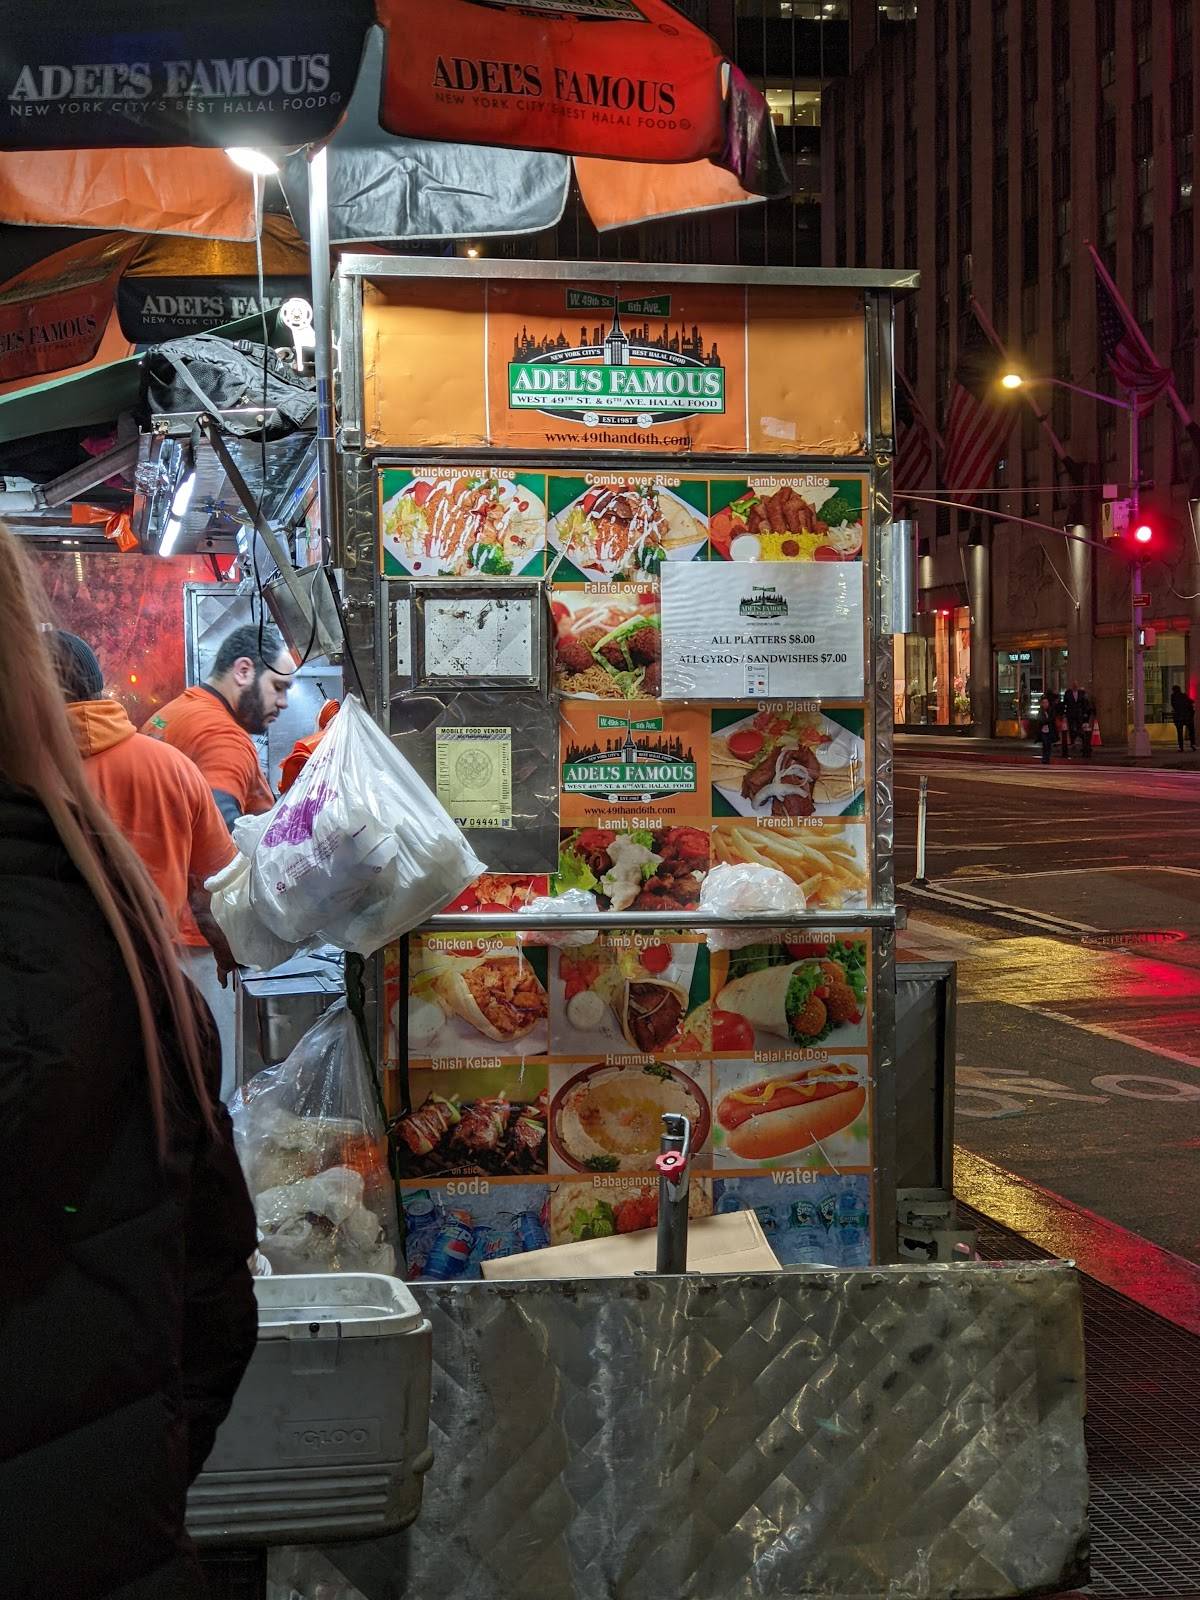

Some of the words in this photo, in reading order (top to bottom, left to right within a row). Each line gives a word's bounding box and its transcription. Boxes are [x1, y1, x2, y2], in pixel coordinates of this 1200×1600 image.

[8, 62, 152, 101] ADEL'S
[162, 54, 331, 98] FAMOUS
[433, 55, 543, 97] ADEL'S
[554, 66, 676, 115] FAMOUS
[10, 104, 49, 117] NEW
[59, 102, 102, 114] YORK
[112, 101, 166, 113] CITY'S
[176, 100, 214, 113] BEST
[224, 101, 275, 113] HALAL
[435, 92, 465, 105] NEW
[472, 94, 510, 110] YORK
[559, 106, 586, 121] BEST
[592, 112, 631, 127] HALAL
[141, 295, 224, 318] ADEL'S
[230, 297, 282, 318] FAM
[582, 295, 599, 306] 49th
[627, 303, 641, 312] 6th
[643, 301, 661, 313] Ave.
[142, 316, 165, 324] NEW
[30, 314, 97, 345] FAMOUS
[550, 353, 564, 362] NEW
[564, 350, 581, 359] YORK
[582, 349, 601, 357] CITY'S
[648, 351, 668, 360] HALAL
[668, 355, 686, 365] FOOD
[514, 368, 603, 392] ADEL'S
[609, 370, 720, 395] FAMOUS
[517, 396, 547, 404] WEST
[551, 396, 574, 404] 49TH
[577, 397, 593, 405] ST.
[624, 398, 648, 406] AVE.
[649, 399, 684, 407] HALAL
[688, 400, 717, 408] FOOD
[545, 432, 692, 447] www.49thand6th.com
[412, 467, 460, 478] Chicken
[461, 469, 487, 479] over
[490, 468, 515, 480] Rice
[585, 474, 624, 487] Combo
[628, 477, 651, 487] over
[656, 475, 680, 487] Rice
[747, 476, 776, 487] Lamb
[777, 478, 803, 488] over
[806, 476, 830, 487] Rice
[584, 582, 621, 594] Falafel
[623, 584, 649, 594] over
[711, 635, 732, 645] ALL
[735, 635, 787, 645] PLATTERS
[789, 634, 815, 645] $8.00
[679, 655, 699, 664] ALL
[701, 654, 739, 664] GYROS
[747, 654, 818, 664] SANDWISHES
[820, 653, 847, 664] $7.00
[757, 701, 783, 713] Gyro
[787, 701, 821, 712] Platter
[566, 766, 620, 780] ADEL'S
[625, 765, 694, 780] FAMOUS
[584, 806, 676, 816] www.49thand6th.com
[470, 818, 499, 826] 04441
[598, 817, 628, 829] Lamb
[632, 817, 662, 829] Salad
[756, 816, 793, 828] French
[797, 816, 823, 827] Fries
[428, 938, 473, 950] Chicken
[477, 937, 504, 951] Gyro
[600, 936, 631, 947] Lamb
[634, 935, 661, 948] Gyro
[785, 931, 836, 945] Sandwich
[432, 1056, 464, 1070] Shish
[466, 1055, 502, 1069] Kebab
[606, 1053, 655, 1066] Hummus
[754, 1050, 781, 1062] Halal
[785, 1050, 803, 1062] Hot
[806, 1049, 828, 1063] Dog
[593, 1174, 661, 1190] Babaganous
[771, 1167, 818, 1185] water
[446, 1177, 489, 1196] soda
